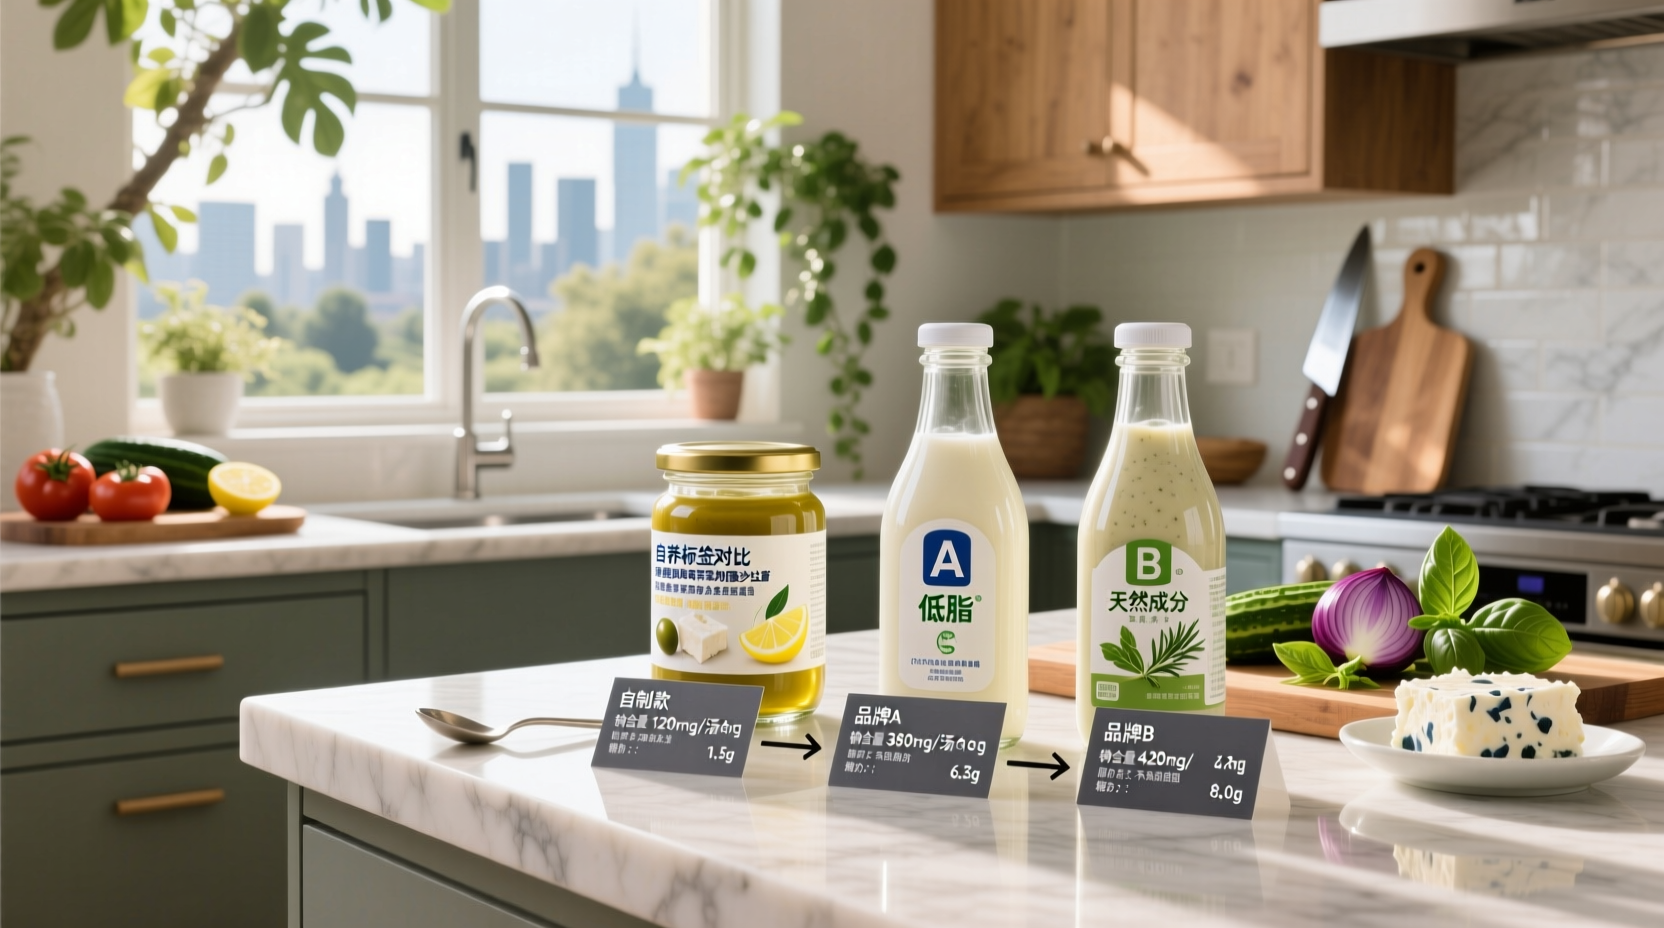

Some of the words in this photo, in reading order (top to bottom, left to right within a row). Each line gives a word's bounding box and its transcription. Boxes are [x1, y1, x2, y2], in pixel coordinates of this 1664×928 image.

[929, 540, 965, 578] A
[1136, 546, 1162, 580] B
[918, 593, 974, 623] 低脂
[1108, 590, 1189, 613] 天然成分
[619, 687, 671, 710] 自制款
[854, 706, 902, 726] 品牌A
[1104, 721, 1155, 744] 品牌B
[707, 745, 735, 764] 1.5g
[950, 764, 981, 785] 6.3g
[1209, 783, 1243, 804] 8.0g
